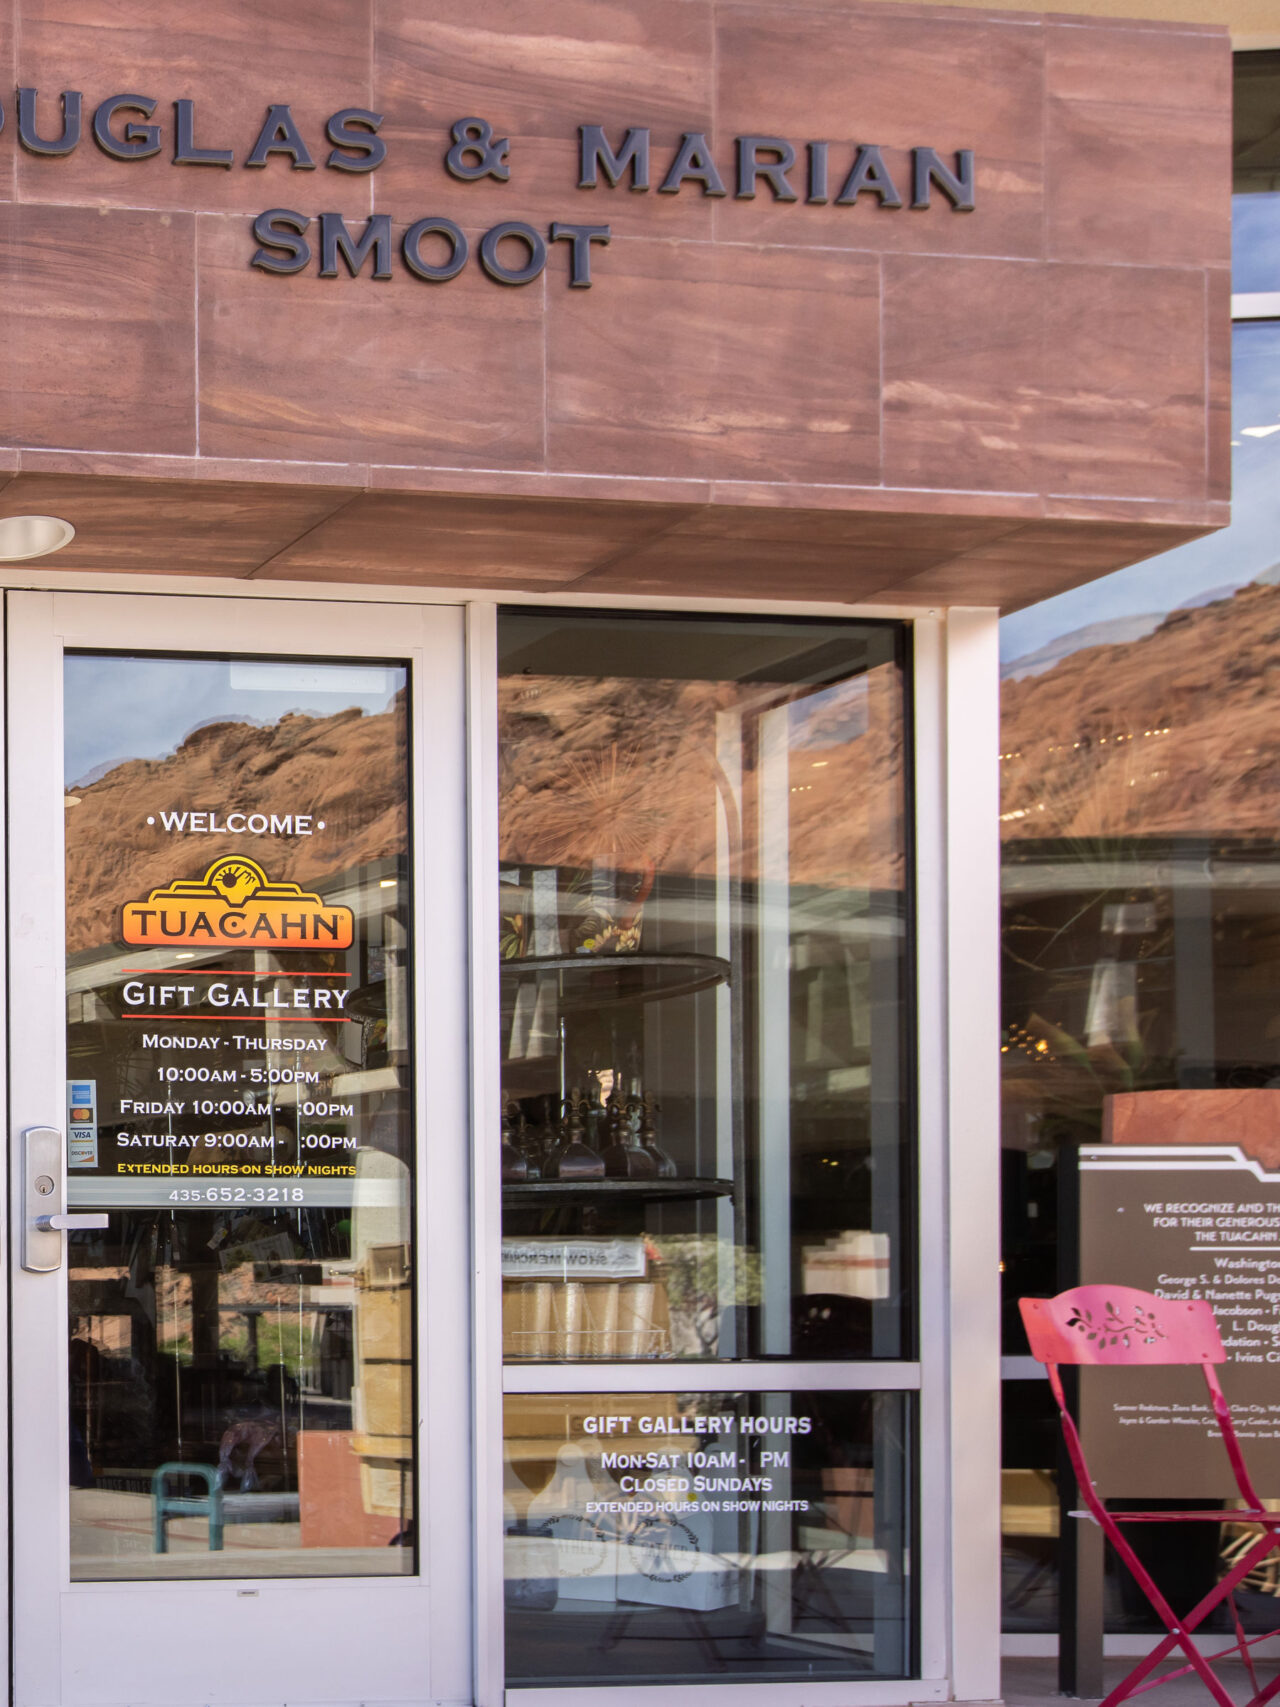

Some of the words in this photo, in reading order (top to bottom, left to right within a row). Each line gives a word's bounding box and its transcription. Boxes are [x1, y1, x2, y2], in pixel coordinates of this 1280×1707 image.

[446, 117, 511, 183] &
[577, 124, 976, 213] MARIAN
[251, 208, 611, 290] SMOOT
[159, 811, 313, 835] WELCOME
[131, 910, 340, 941] TUACAHN
[123, 981, 195, 1006] GIFT
[207, 983, 350, 1009] GALLERY
[142, 1034, 220, 1050] MONDAY
[232, 1035, 328, 1051] THURSDAY
[157, 1067, 237, 1082] 10:00AM
[250, 1068, 319, 1083] 5:00PM
[120, 1099, 185, 1115] FRIDAY
[192, 1100, 271, 1116] 10:00AM
[73, 1131, 91, 1139] VISA
[116, 1132, 200, 1148] SATURAY
[204, 1133, 274, 1148] 9:00AM
[117, 1164, 190, 1174] EXTENDED
[192, 1164, 239, 1175] HOURS
[242, 1165, 262, 1175] ON
[264, 1165, 306, 1175] SHOW
[308, 1165, 357, 1176] NIGHTS
[169, 1187, 304, 1202] 435-652-3218
[1143, 1203, 1164, 1213] WE
[1165, 1203, 1235, 1214] RECOGNIZE
[1236, 1203, 1265, 1213] AND
[1153, 1217, 1179, 1227] FOR
[1180, 1217, 1214, 1227] THEIR
[1194, 1231, 1217, 1241] THE
[1219, 1231, 1278, 1241] TUACAHN
[1157, 1274, 1197, 1287] George
[1224, 1274, 1265, 1284] Dolores
[1205, 1289, 1252, 1300] Nanette
[583, 1416, 632, 1434] GIFT
[638, 1416, 734, 1434] GALLERY
[740, 1416, 812, 1434] HOURS
[601, 1452, 680, 1469] MON-SAT
[687, 1452, 736, 1468] 10AM
[760, 1451, 789, 1468] PM
[620, 1475, 689, 1492] CLOSED
[693, 1475, 773, 1492] SUNDAYS
[585, 1502, 654, 1513] EXTENDED
[656, 1501, 700, 1513] HOURS
[701, 1501, 720, 1512] ON
[721, 1501, 761, 1512] SHOW
[762, 1500, 809, 1512] NIGHTS
